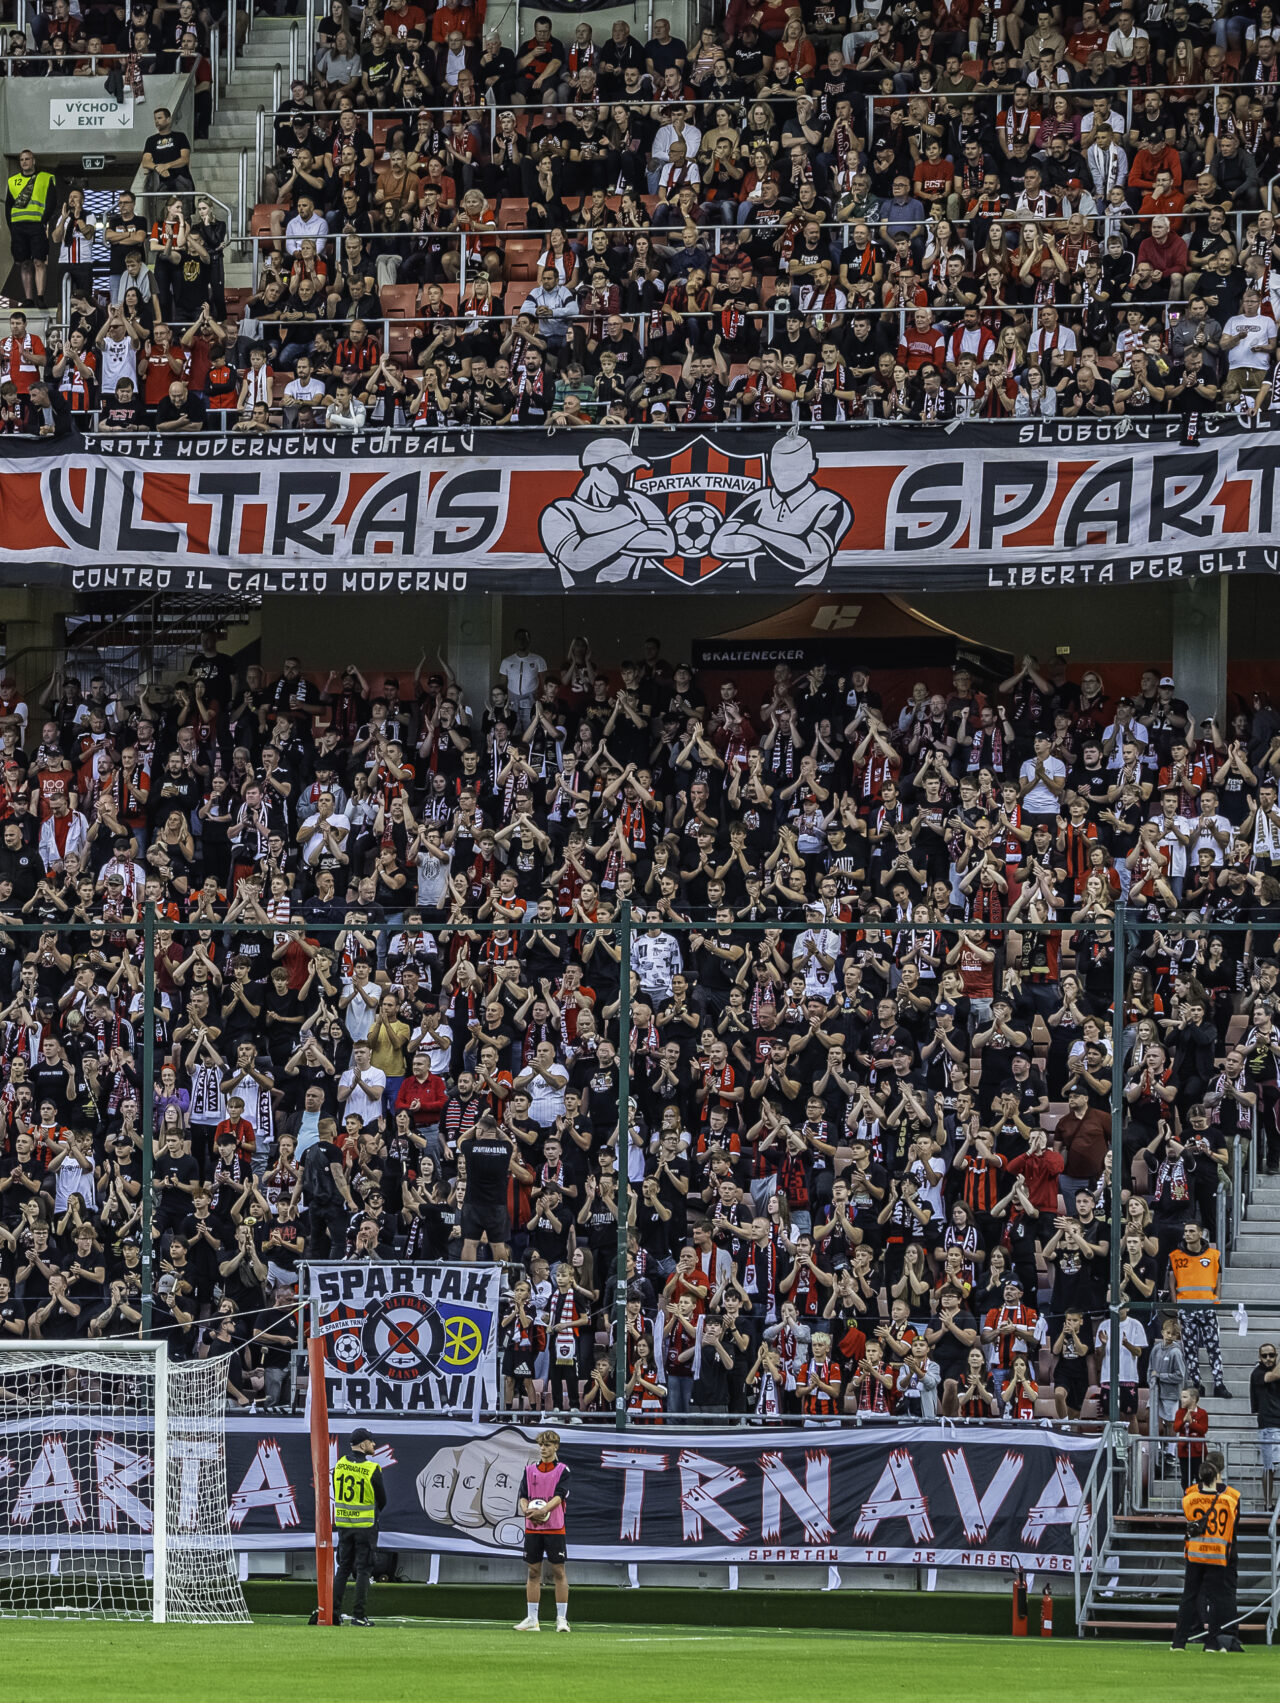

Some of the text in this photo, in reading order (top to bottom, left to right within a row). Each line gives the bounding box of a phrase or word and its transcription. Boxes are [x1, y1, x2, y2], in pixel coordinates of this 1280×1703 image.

[65, 101, 118, 113] VÝCHOD
[77, 116, 104, 126] EXIT
[14, 177, 24, 187] 12
[1166, 420, 1220, 438] PE
[84, 436, 163, 456] PROTI
[640, 476, 756, 493] SPARTAK TRNAVA
[49, 467, 503, 556] ULTRAS
[988, 563, 1114, 588] LIBERTA
[1129, 557, 1183, 580] PER
[1199, 551, 1247, 574] GLI
[72, 567, 468, 592] CONTRO IL CALCIO MODERNO
[712, 649, 805, 661] KALTENECKER
[42, 780, 64, 789] 100
[317, 1267, 492, 1304] SPARTAK
[385, 1298, 428, 1313] ULTRAS
[325, 1320, 349, 1333] SPARTAK
[388, 1367, 420, 1380] BAND
[336, 1473, 365, 1504] 131
[600, 1446, 1094, 1547] TRNAVA
[865, 1550, 888, 1562] TO
[912, 1551, 937, 1563] JE
[961, 1552, 1011, 1567] NAŠE
